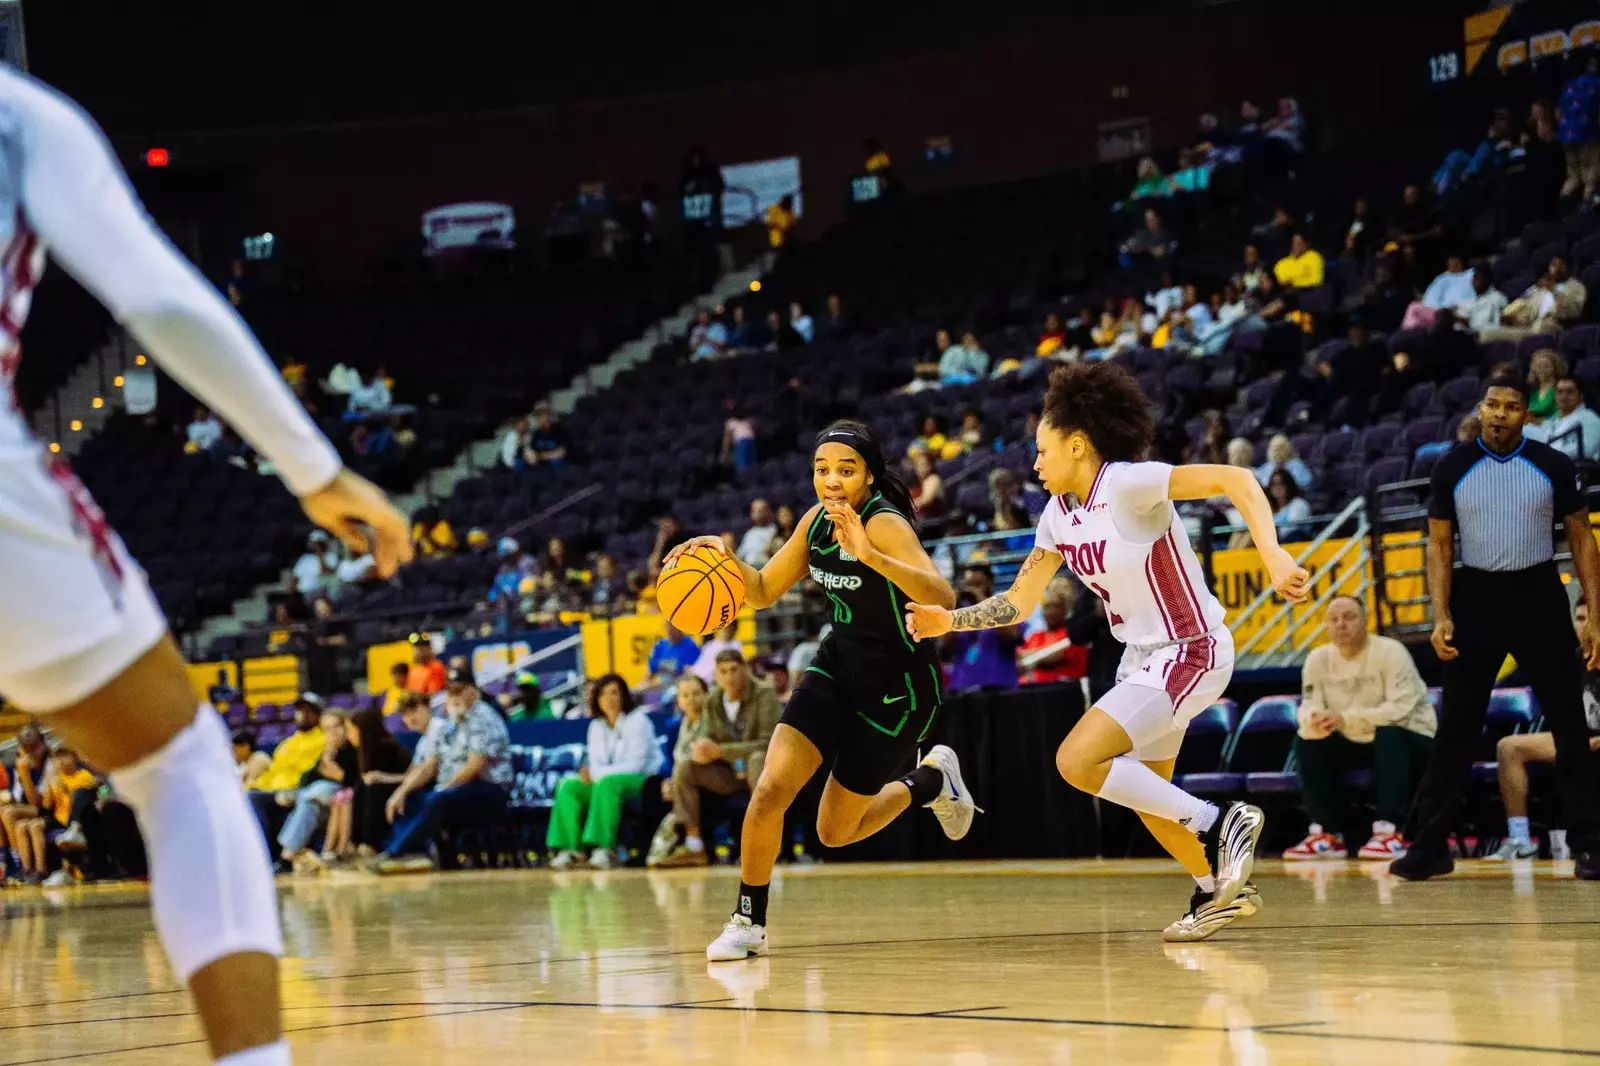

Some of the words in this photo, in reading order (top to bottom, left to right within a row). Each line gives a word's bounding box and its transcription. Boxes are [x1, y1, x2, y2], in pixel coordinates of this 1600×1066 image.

[1428, 52, 1459, 83] 129
[1055, 539, 1107, 576] TROY
[824, 572, 862, 591] HERD
[826, 591, 852, 624] 10
